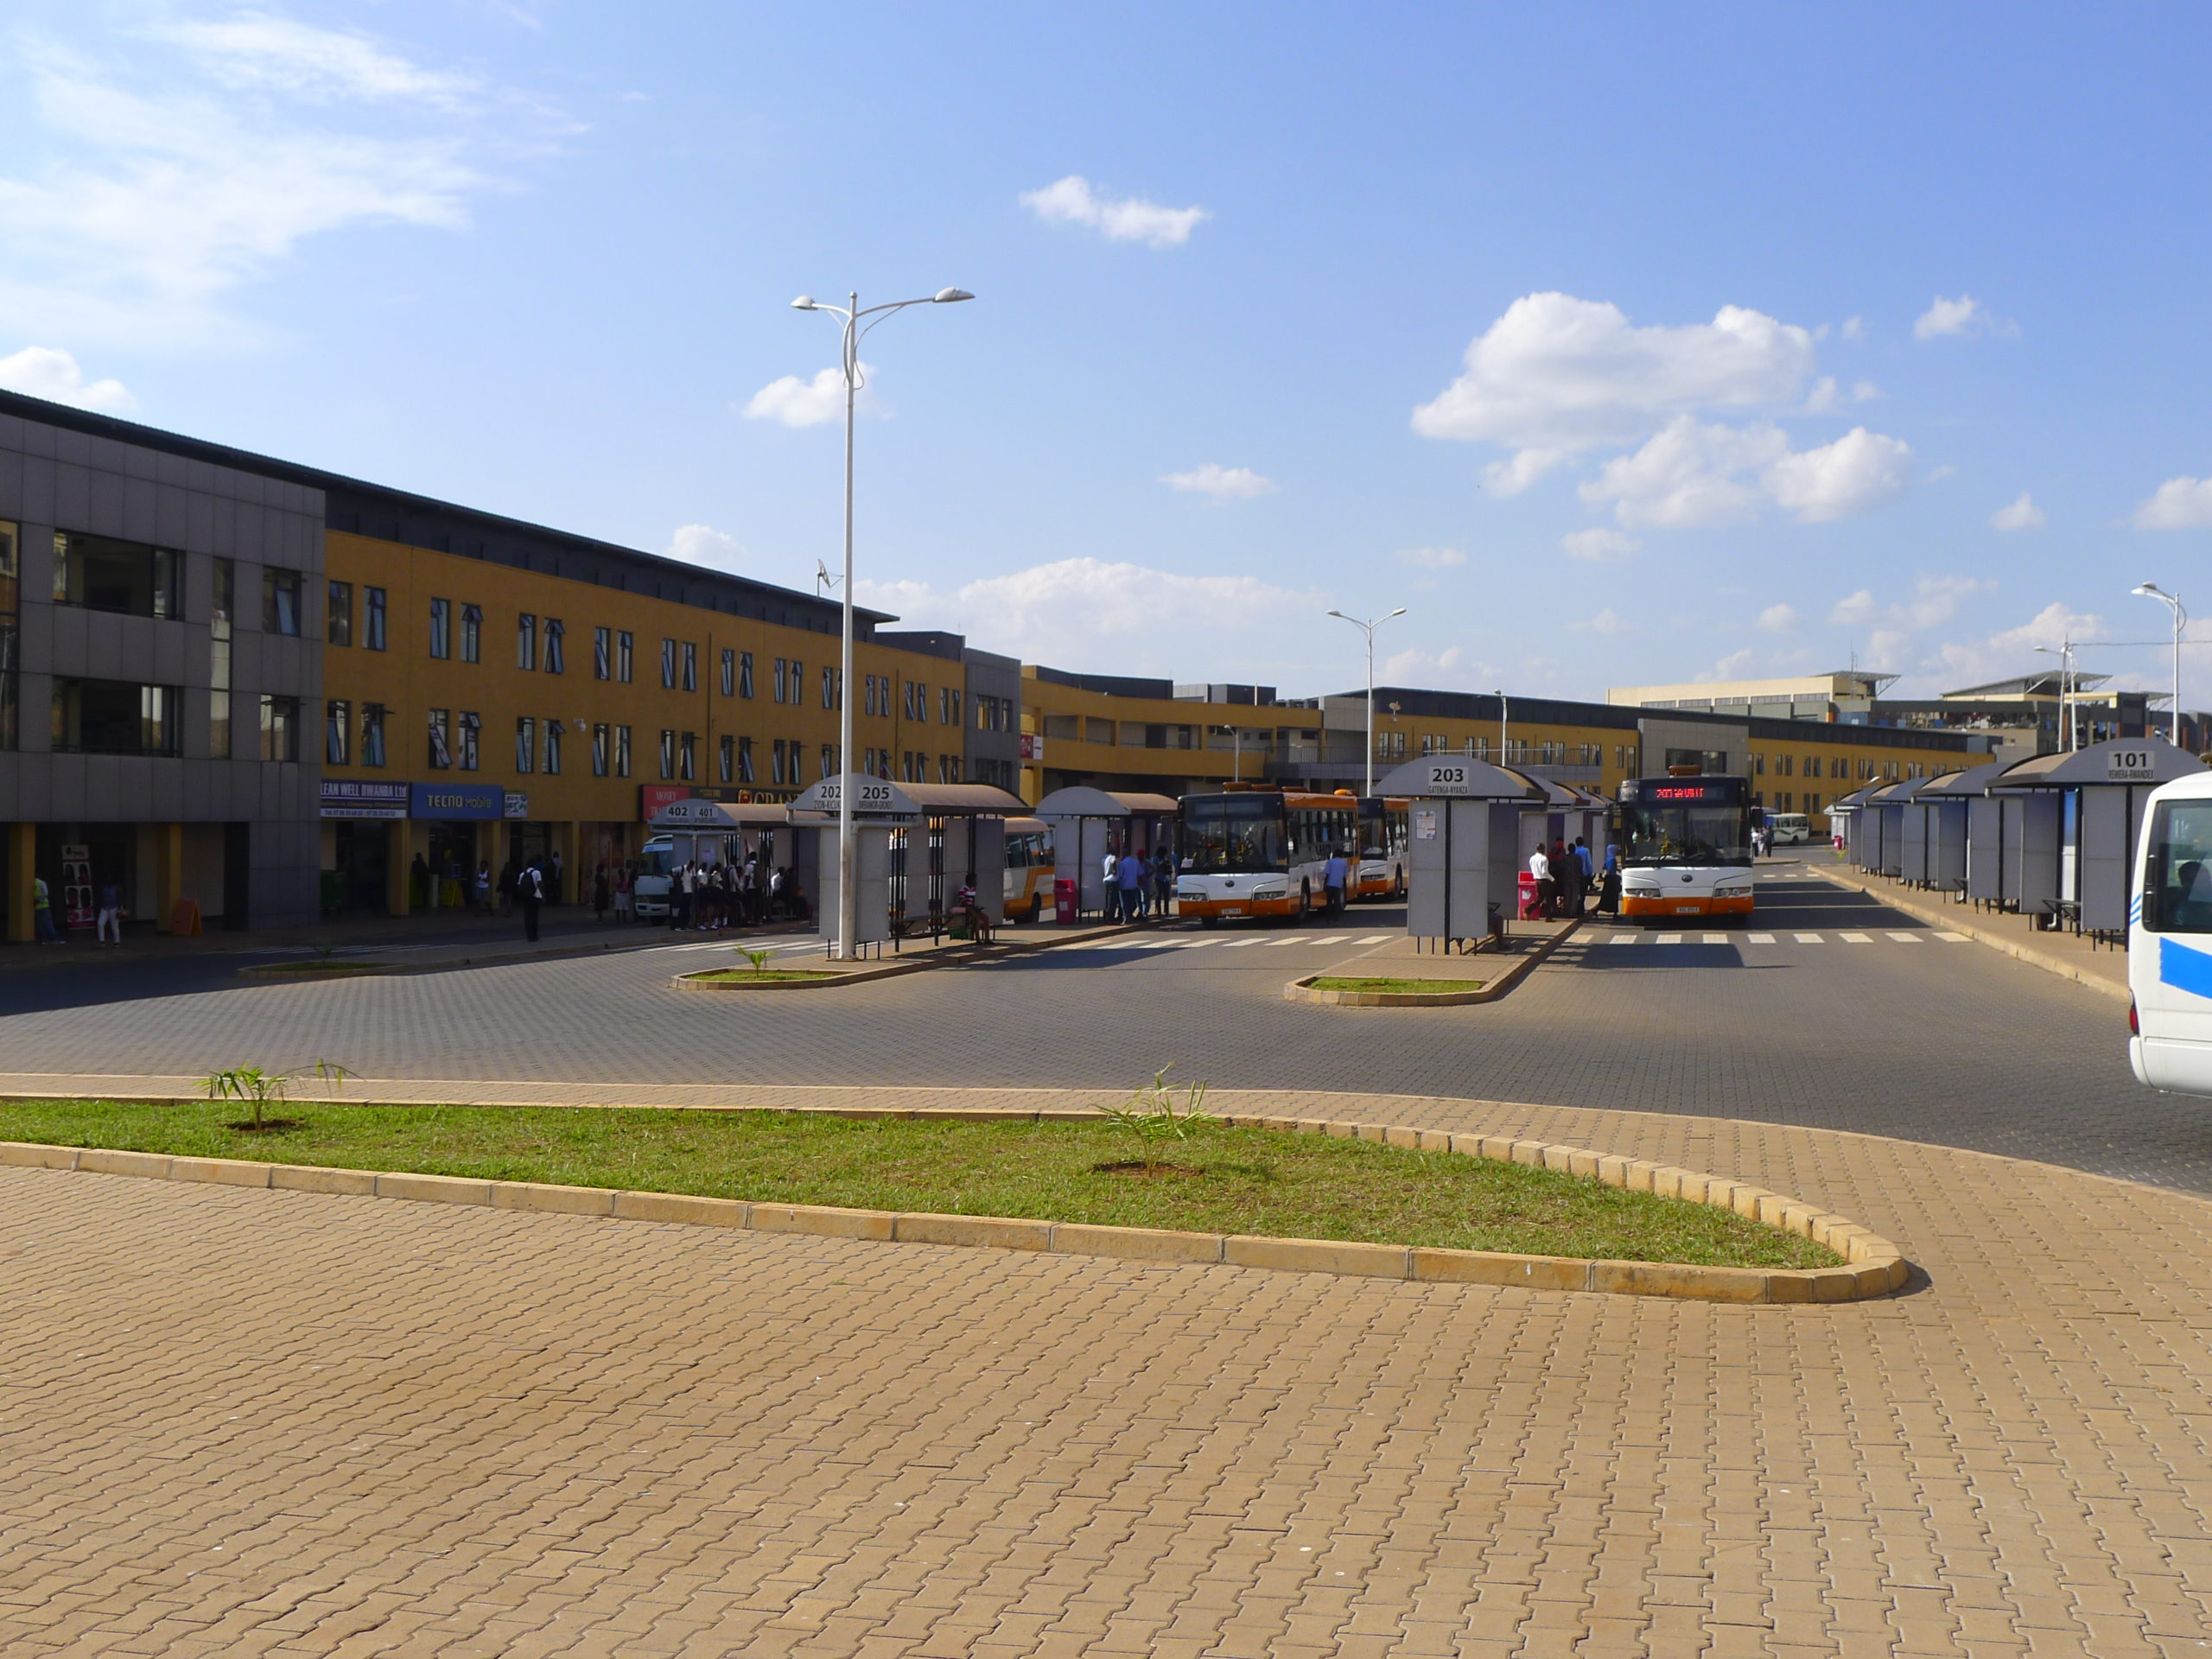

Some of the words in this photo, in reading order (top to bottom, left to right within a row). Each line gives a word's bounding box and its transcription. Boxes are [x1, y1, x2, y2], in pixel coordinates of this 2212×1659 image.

[2114, 753, 2146, 767] 101
[1433, 768, 1464, 782] 203
[821, 785, 842, 798] 202
[862, 786, 889, 799] 205
[427, 795, 463, 808] TECNO
[668, 807, 688, 817] 402
[699, 808, 714, 817] 401
